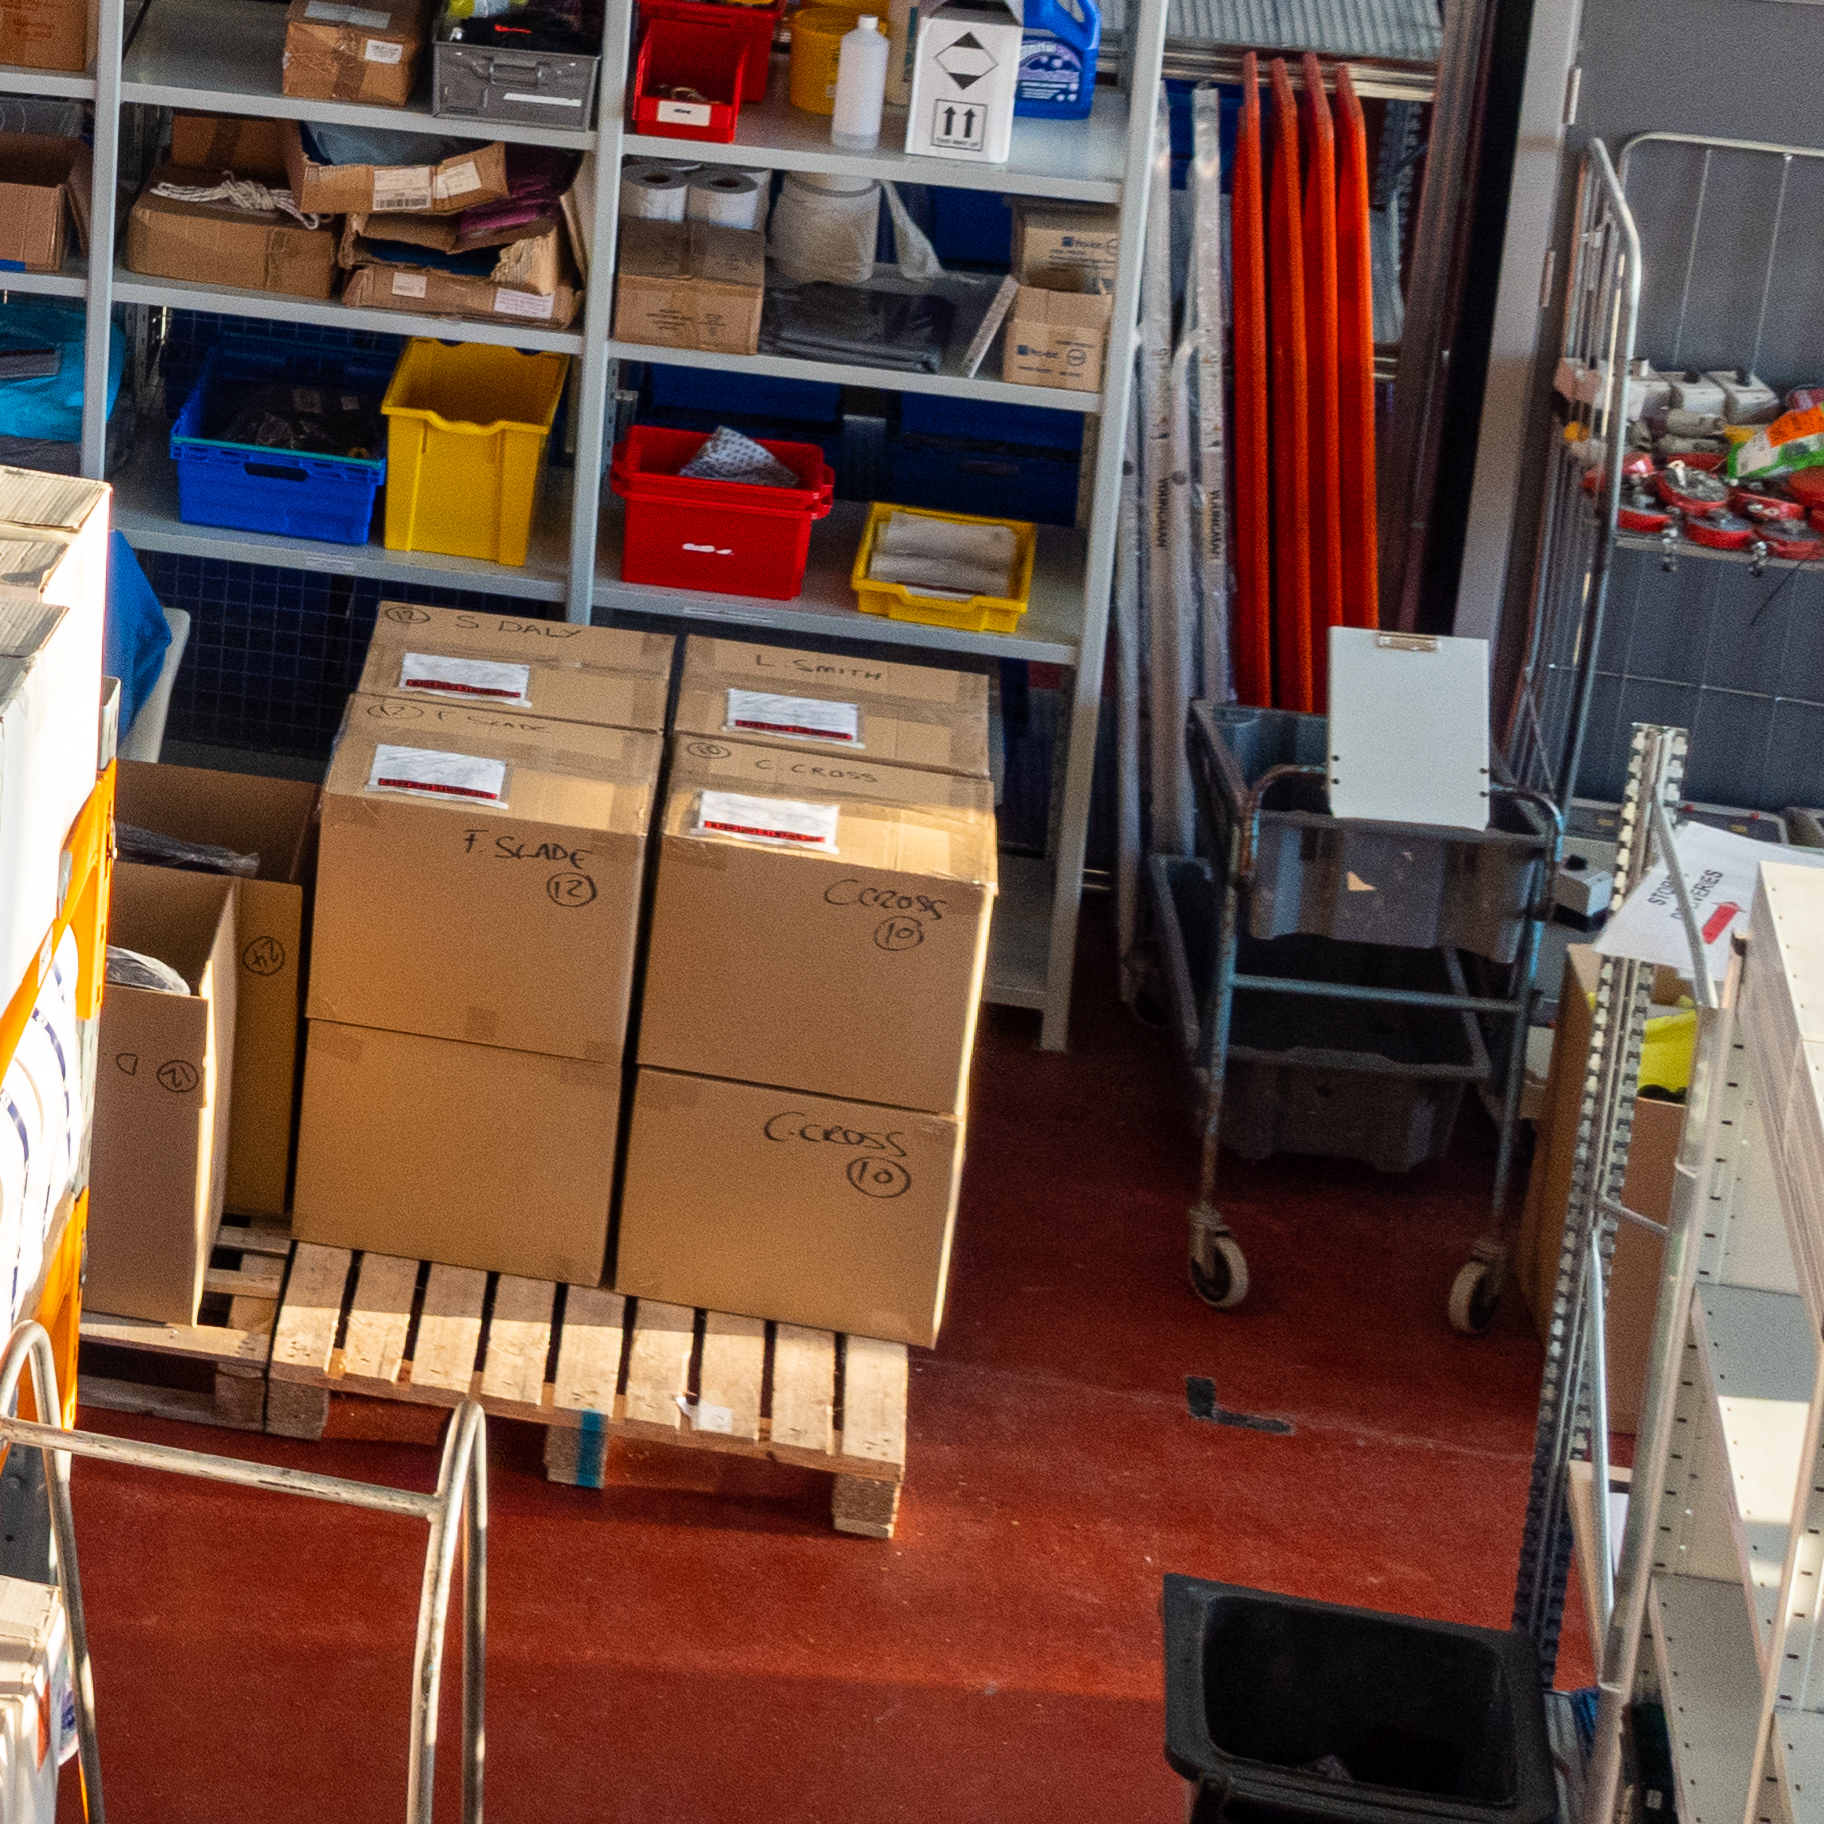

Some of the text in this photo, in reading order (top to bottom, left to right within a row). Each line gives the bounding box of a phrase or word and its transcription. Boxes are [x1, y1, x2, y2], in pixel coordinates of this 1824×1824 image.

[498, 619, 582, 639] DALY
[792, 658, 883, 680] SMITH
[791, 762, 879, 783] CROSS
